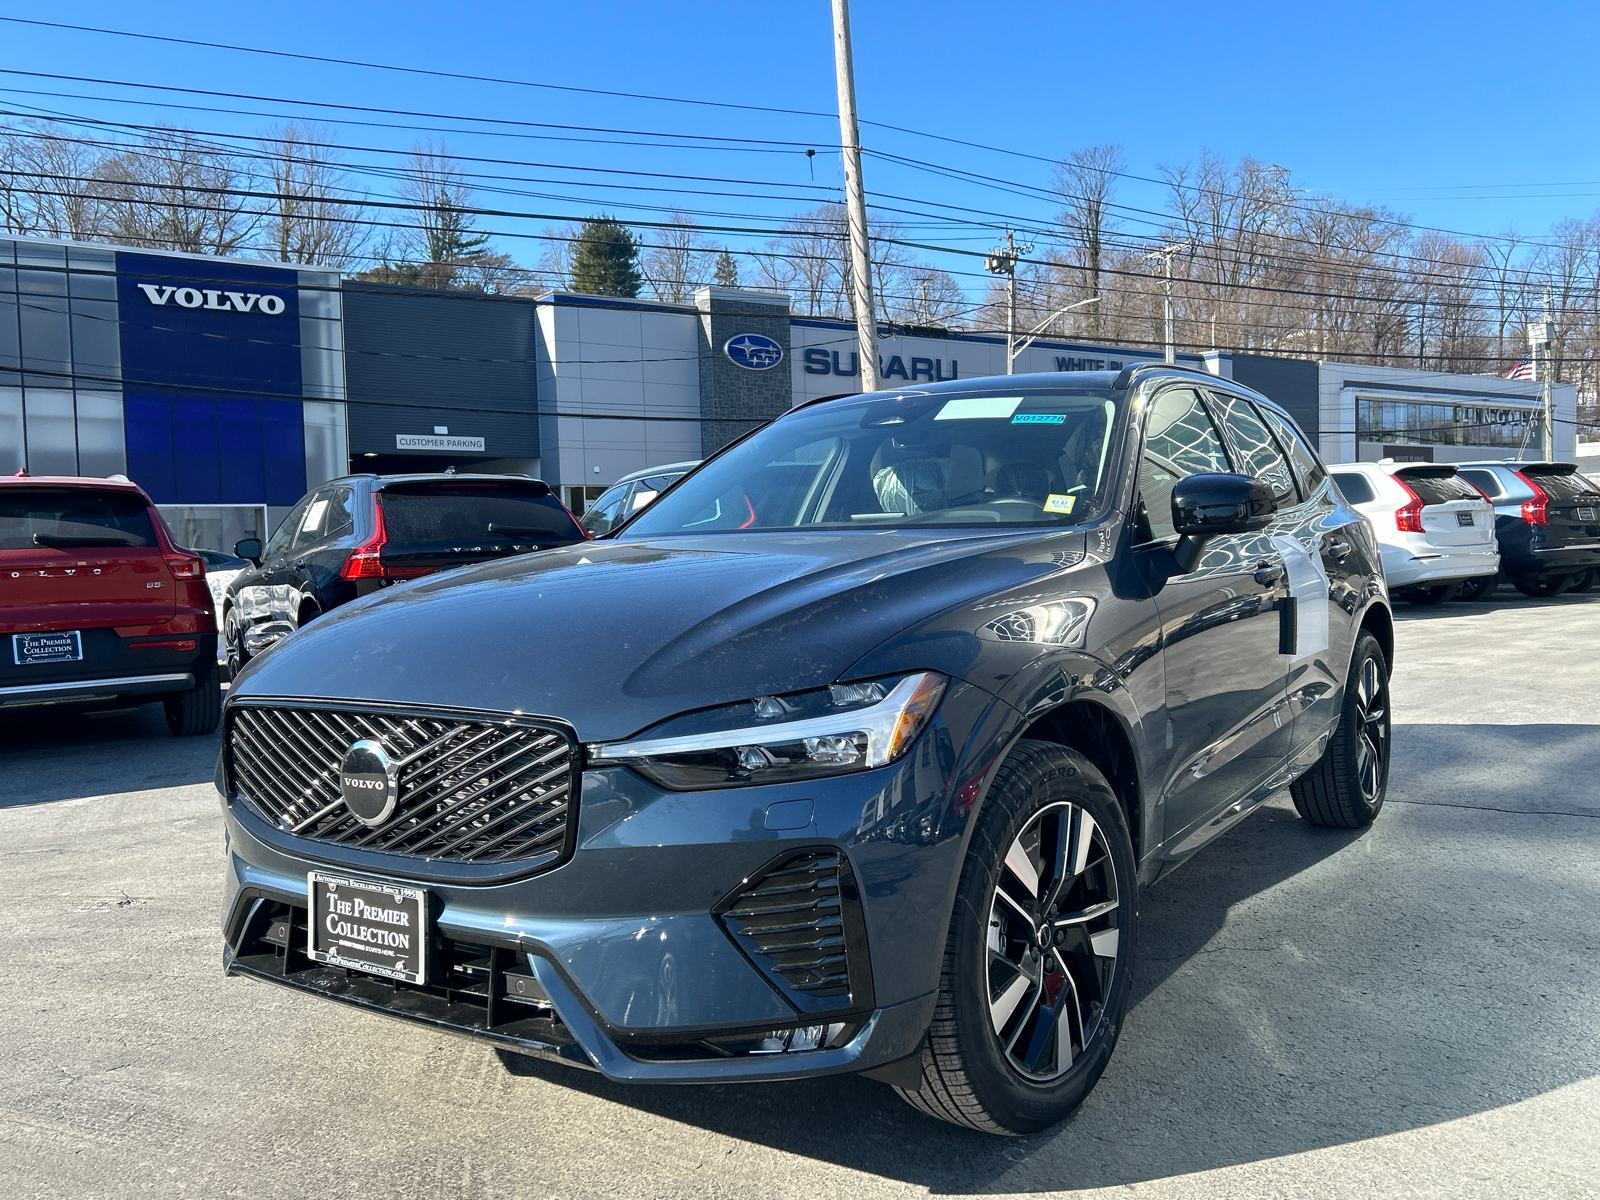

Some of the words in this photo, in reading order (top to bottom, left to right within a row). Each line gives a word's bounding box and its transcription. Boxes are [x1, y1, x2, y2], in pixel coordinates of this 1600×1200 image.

[138, 284, 285, 314] VOLVO
[804, 348, 958, 381] SUARU
[1056, 356, 1104, 371] WHITE
[400, 438, 444, 446] CUSTOMER
[446, 440, 482, 448] PARKING
[11, 568, 102, 578] OLVO
[24, 646, 72, 654] COLLECTION
[344, 778, 384, 790] VOLVO
[316, 874, 349, 886] AUTOMOTIVE
[350, 879, 382, 891] EXCELLENCE
[383, 885, 400, 894] SINCE
[326, 893, 352, 916] THE
[353, 898, 409, 926] PREMIER
[326, 914, 409, 949] COLLECTION
